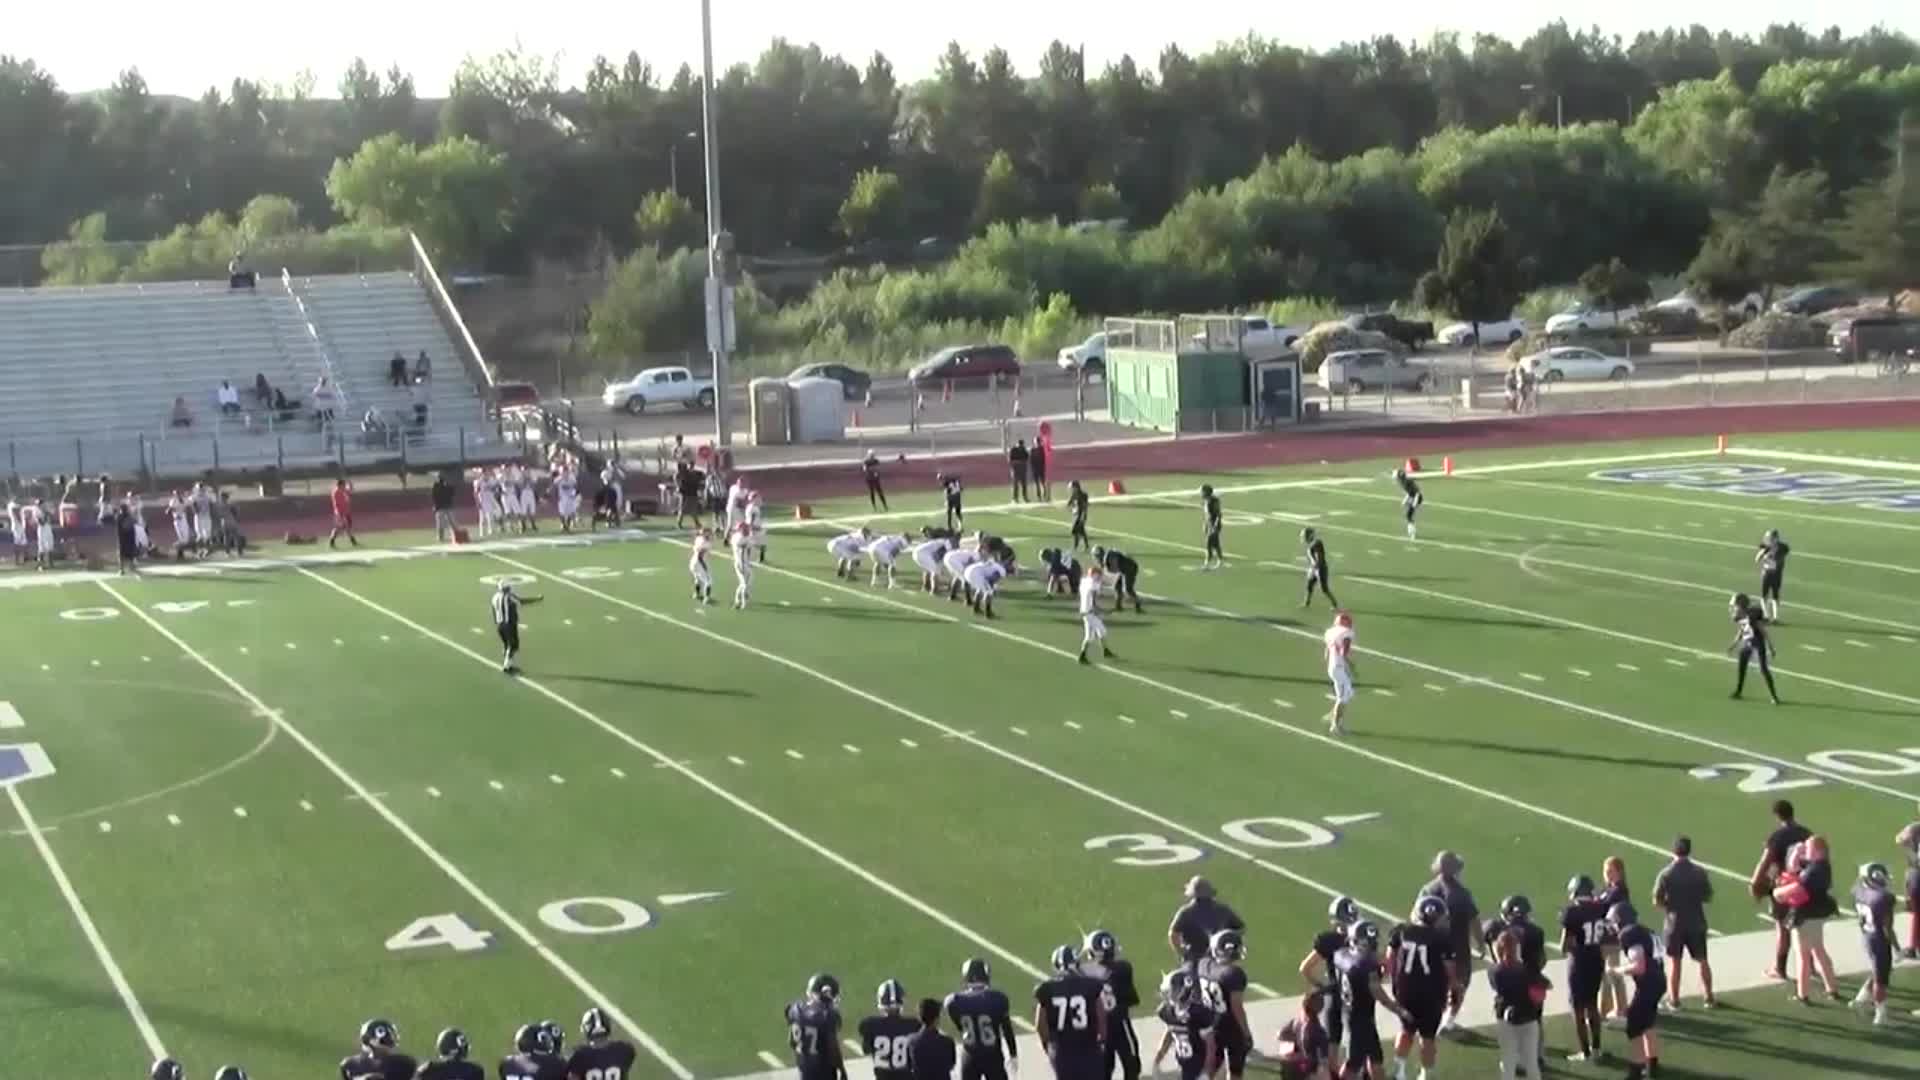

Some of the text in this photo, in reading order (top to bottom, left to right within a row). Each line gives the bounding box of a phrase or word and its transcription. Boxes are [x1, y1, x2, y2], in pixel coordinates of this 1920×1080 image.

[1084, 817, 1335, 866] 30
[386, 897, 650, 951] 40
[1402, 941, 1431, 974] 71
[1051, 995, 1088, 1031] 73
[873, 1035, 909, 1069] 28
